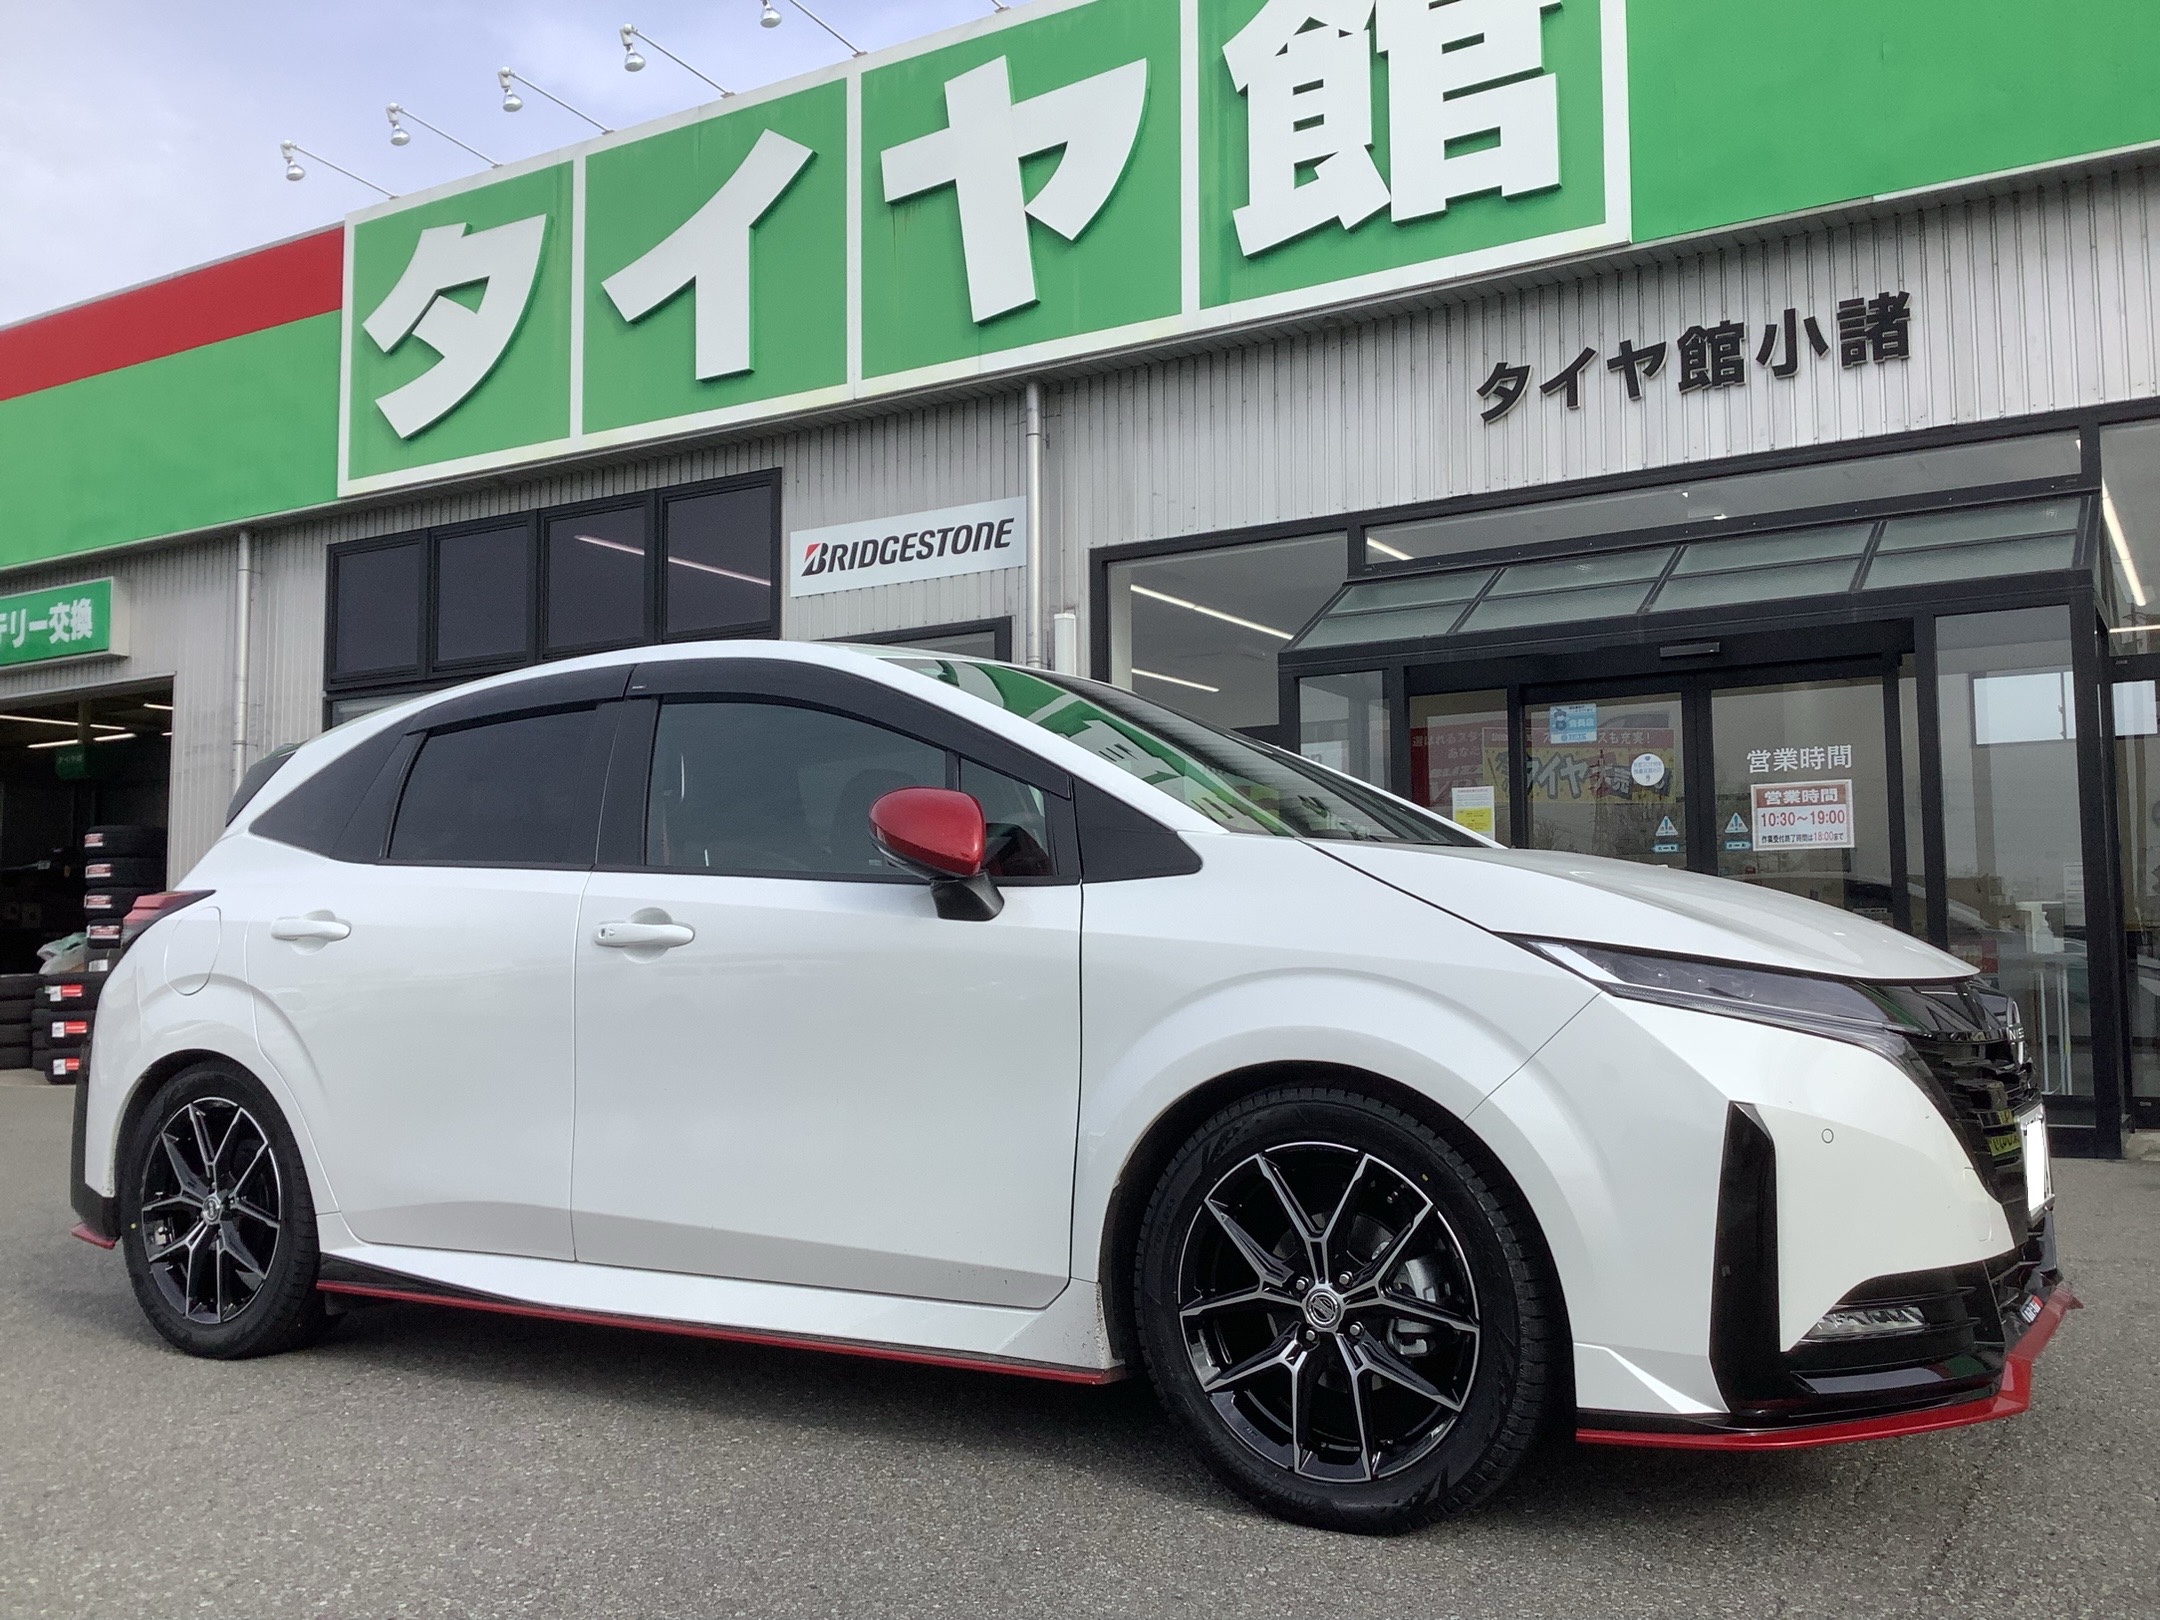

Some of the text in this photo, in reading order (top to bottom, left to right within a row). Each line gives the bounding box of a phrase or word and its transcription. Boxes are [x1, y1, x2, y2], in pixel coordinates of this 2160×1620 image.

[361, 0, 1564, 439] タイヤ館
[1477, 291, 1912, 424] タイヤ館小諸
[801, 517, 1015, 577] BRIDGESTONE
[1747, 744, 1852, 773] 営業時間
[1765, 787, 1838, 805] 営業時間
